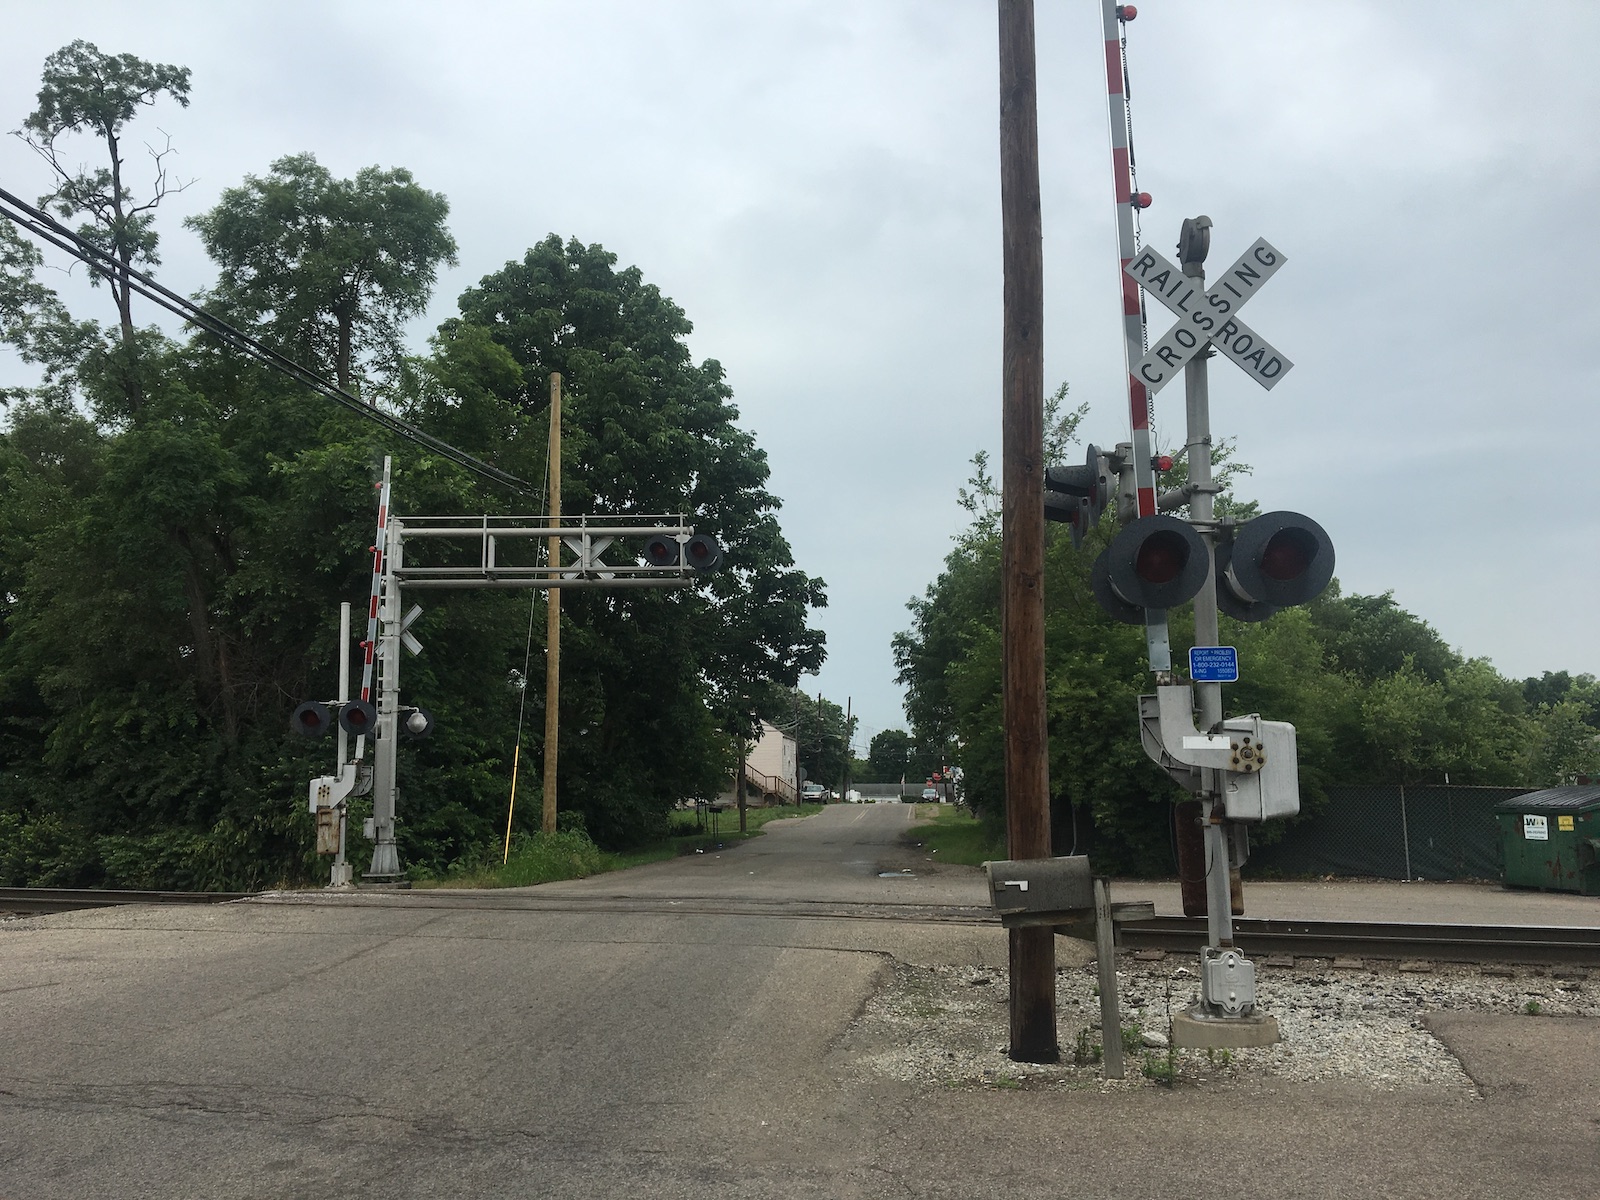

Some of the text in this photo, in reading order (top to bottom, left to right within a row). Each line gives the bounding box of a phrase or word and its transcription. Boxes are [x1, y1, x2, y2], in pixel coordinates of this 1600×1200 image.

[1132, 252, 1283, 379] RAIL ROAD
[1141, 246, 1277, 384] CROSSING
